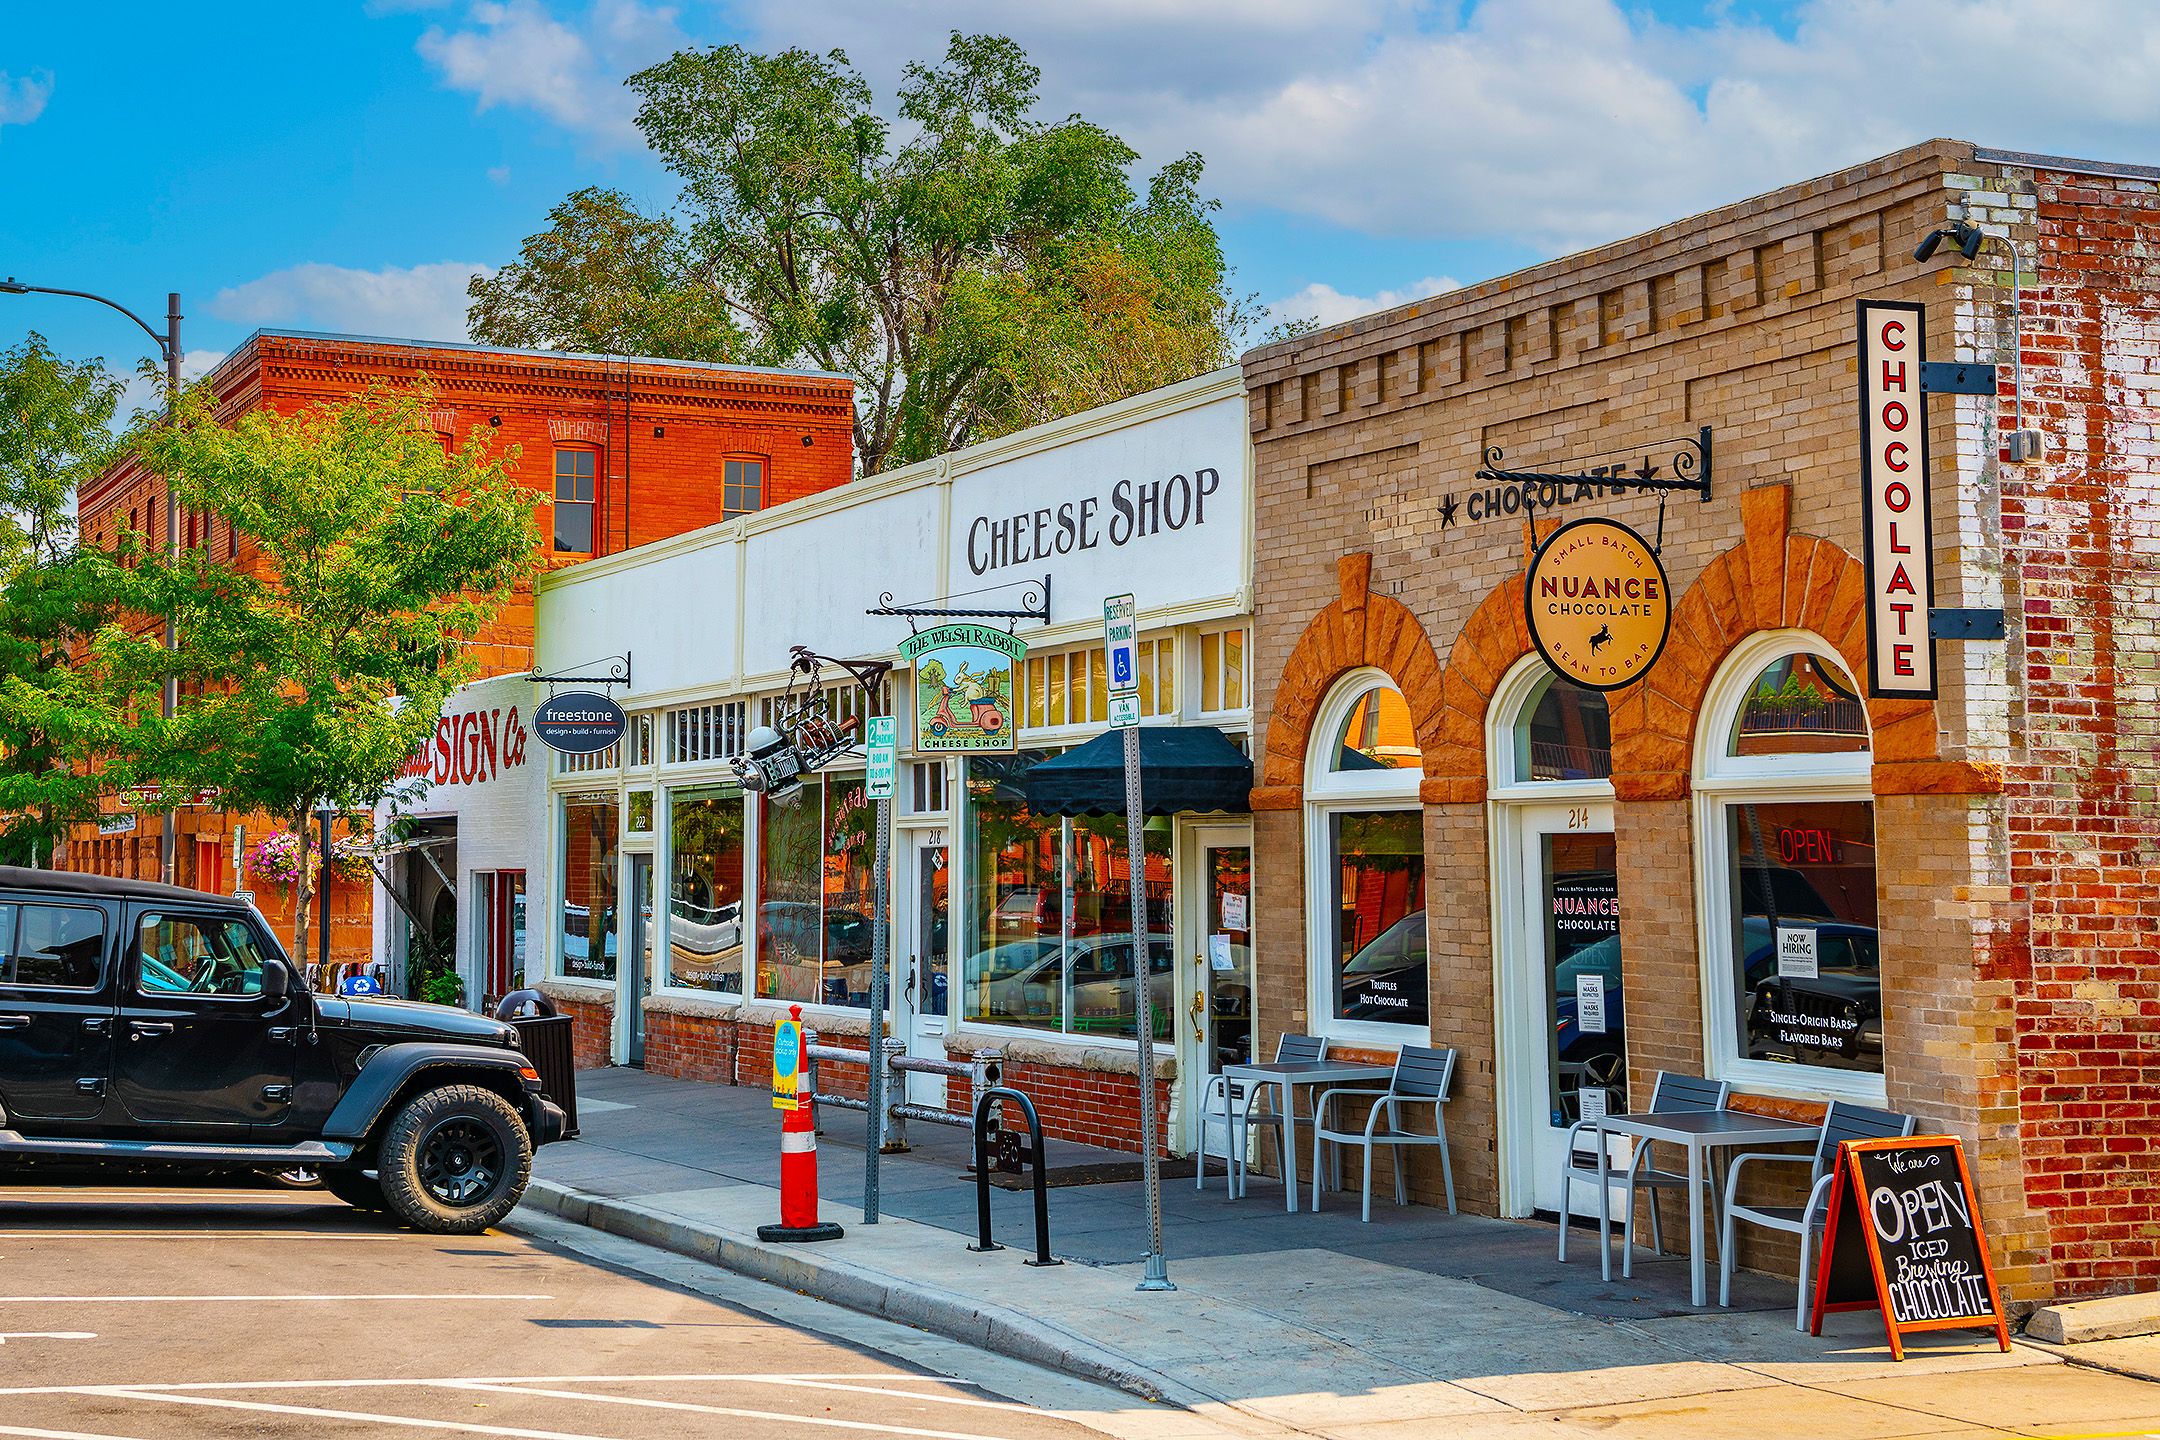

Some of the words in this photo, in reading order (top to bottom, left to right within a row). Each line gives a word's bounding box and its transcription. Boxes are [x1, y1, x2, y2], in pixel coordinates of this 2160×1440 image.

[1467, 463, 1626, 521] CHOCOLATE
[1880, 320, 1916, 677] CHOCOLATE
[967, 496, 1100, 576] CHEESE
[1108, 467, 1220, 547] SHOP
[1553, 536, 1594, 566] SMALL
[1602, 536, 1643, 570] BATCH
[1541, 576, 1659, 600] NUANCE
[1105, 602, 1133, 621] RESERVED
[1549, 603, 1652, 617] CHOCOLATE
[906, 637, 930, 656] THE
[931, 628, 971, 645] WELSH
[973, 628, 1022, 656] RABBIT
[1109, 624, 1132, 643] PARKING
[1553, 642, 1590, 674] BEAN
[1599, 666, 1617, 677] TO
[1625, 642, 1649, 670] BAR
[546, 708, 613, 721] freestone
[1114, 712, 1136, 722] ACCESSIBLE
[1118, 703, 1130, 713] VAN
[546, 728, 568, 736] design
[869, 723, 876, 744] 2
[876, 733, 894, 744] PARKING
[435, 708, 500, 786] SIGN
[924, 739, 969, 748] CHEESE
[975, 739, 1008, 748] SHOP
[635, 816, 646, 828] 222
[1569, 807, 1589, 829] 214
[928, 830, 942, 845] 218
[1780, 829, 1833, 863] OPEN
[1553, 897, 1620, 916] NUANCE
[1557, 919, 1616, 931] CHOCOLATE
[1787, 933, 1807, 943] NOW
[1782, 943, 1812, 955] HIRING
[1370, 979, 1397, 991] TRUFFLES
[1360, 993, 1373, 1005] HOT
[1374, 994, 1409, 1007] CHOCOLATE
[1830, 1016, 1852, 1031] BARS
[1780, 1029, 1820, 1046] FLAVORED
[1821, 1034, 1843, 1048] BARS
[1874, 1150, 1908, 1174] We
[1870, 1180, 1973, 1243] OPEN
[1907, 1239, 1949, 1261] ICED
[1895, 1255, 1970, 1284] Brewing
[1888, 1274, 1992, 1322] CHOCOLATE
